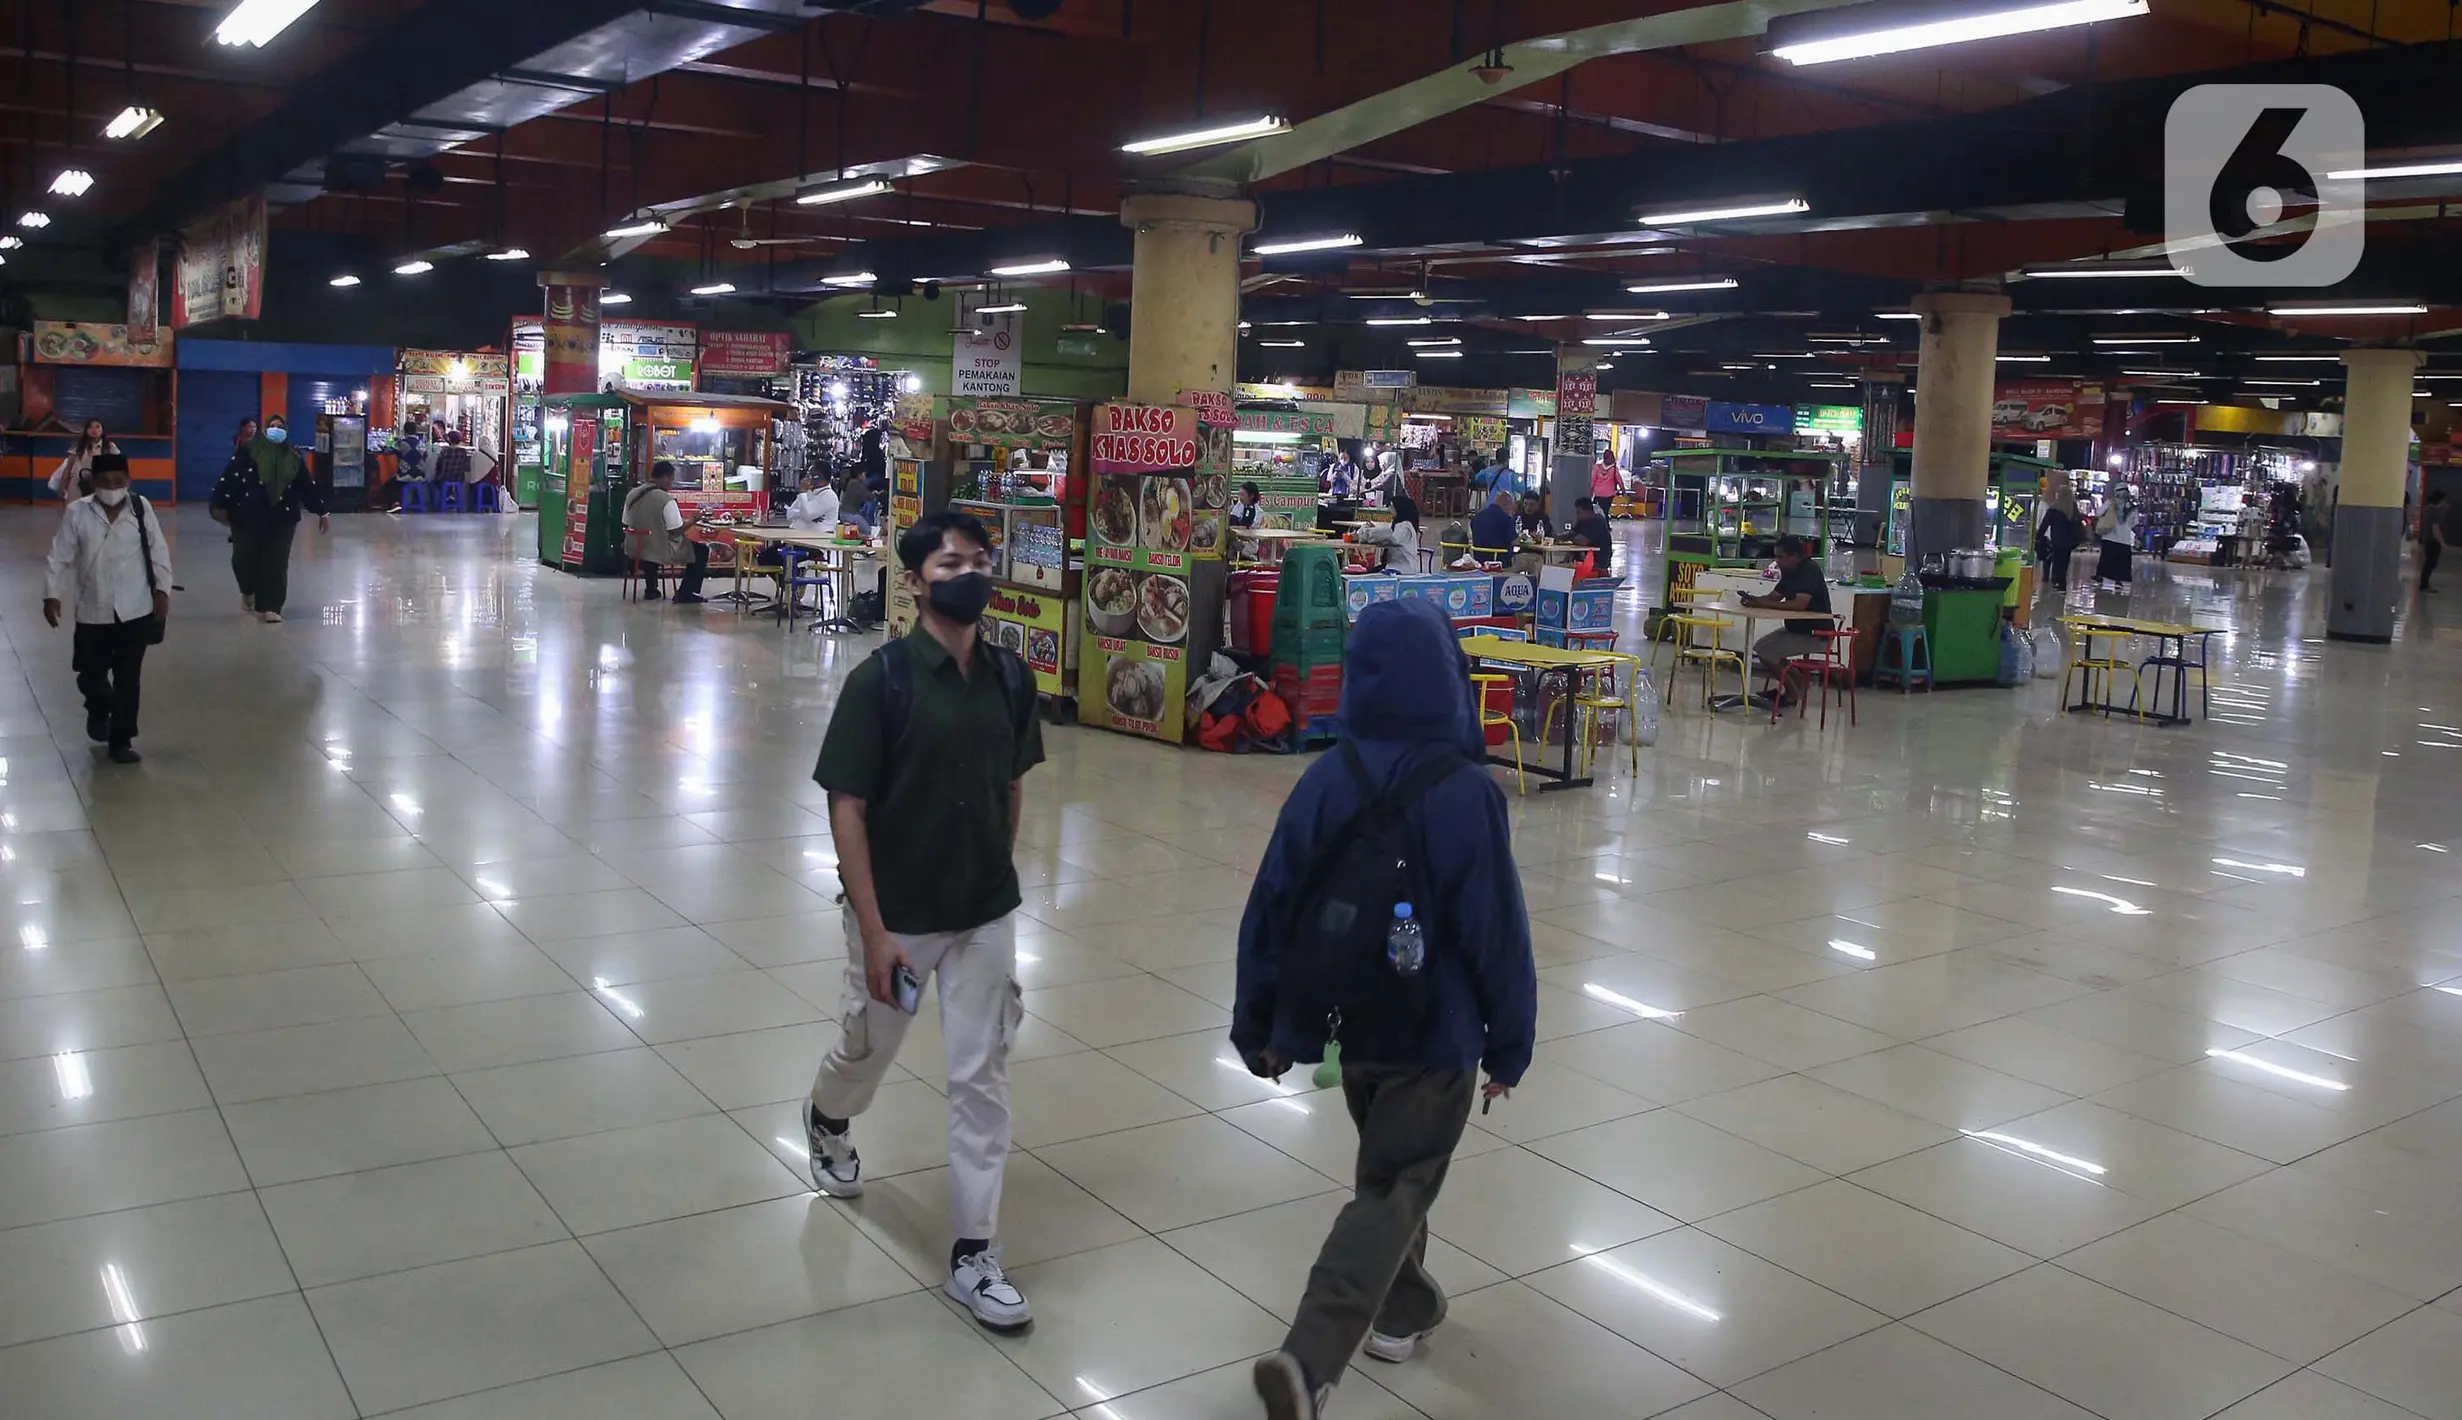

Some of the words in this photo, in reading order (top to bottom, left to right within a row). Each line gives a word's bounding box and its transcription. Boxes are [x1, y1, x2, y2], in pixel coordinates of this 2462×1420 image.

[974, 358, 1000, 368] STOP
[637, 364, 677, 378] ROBOT
[958, 369, 1016, 381] PEMAKAIAN
[962, 382, 1010, 393] KANTONG
[1191, 391, 1228, 407] BAKSO
[1108, 405, 1175, 434] BAKSO
[1731, 409, 1764, 425] vivo
[1092, 433, 1142, 464] KHAS
[1143, 436, 1197, 468] SOLO
[1273, 494, 1315, 509] Campur
[1505, 585, 1528, 597] AQUA
